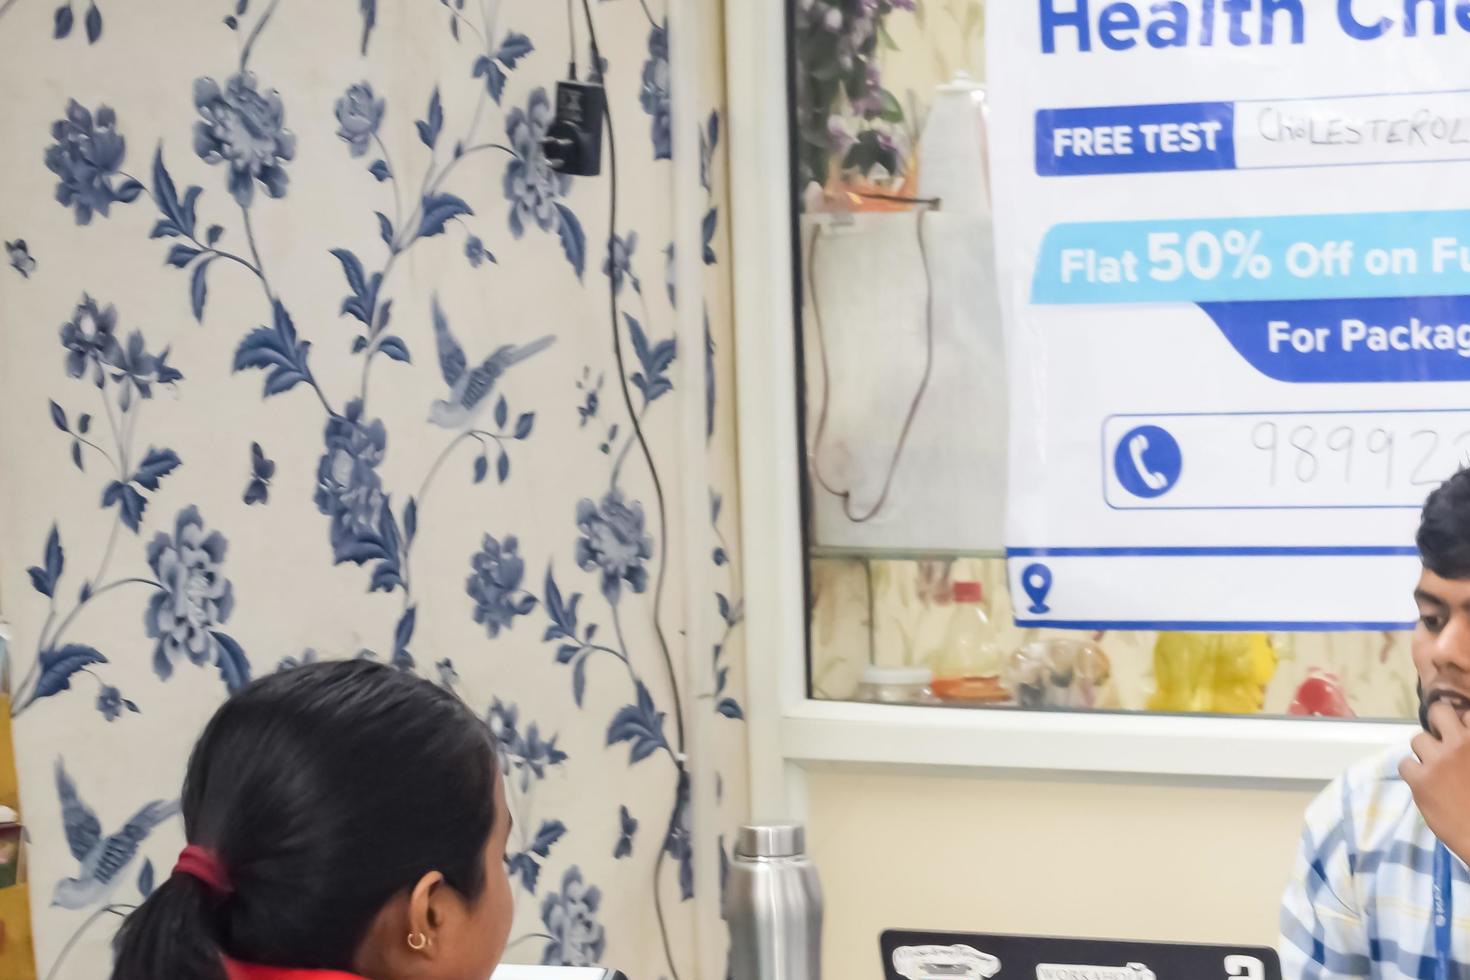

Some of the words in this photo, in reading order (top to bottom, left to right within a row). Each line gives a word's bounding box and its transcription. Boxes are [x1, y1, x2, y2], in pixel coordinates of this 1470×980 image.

[1040, 0, 1305, 54] Health
[1053, 124, 1132, 157] FREE
[1141, 122, 1220, 154] TEST
[1061, 250, 1137, 284] Flat
[1147, 230, 1271, 282] 50%
[1286, 241, 1353, 278] Off
[1365, 247, 1416, 277] on
[1268, 320, 1330, 354] For
